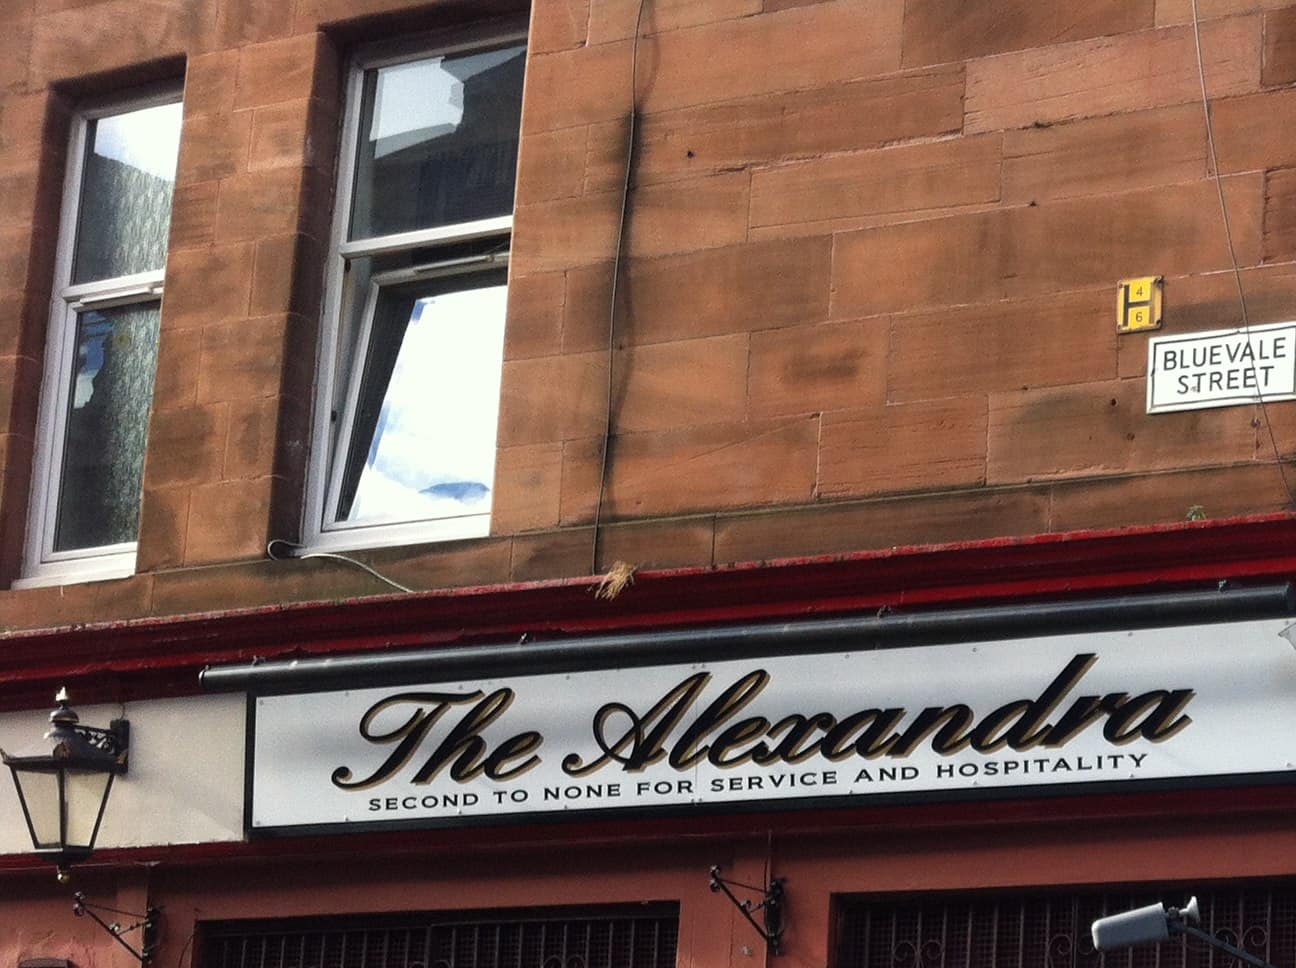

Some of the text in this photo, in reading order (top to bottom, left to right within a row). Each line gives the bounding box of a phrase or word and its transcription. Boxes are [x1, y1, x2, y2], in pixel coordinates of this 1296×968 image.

[1135, 287, 1143, 297] 4
[1135, 311, 1143, 322] 6
[1163, 336, 1286, 371] BLUEVALE
[1177, 365, 1275, 394] STREET
[331, 653, 1197, 791] The Alexandra
[368, 753, 1150, 812] SECOND TO NONE FOR SERVICE AND HOSPITALITY
